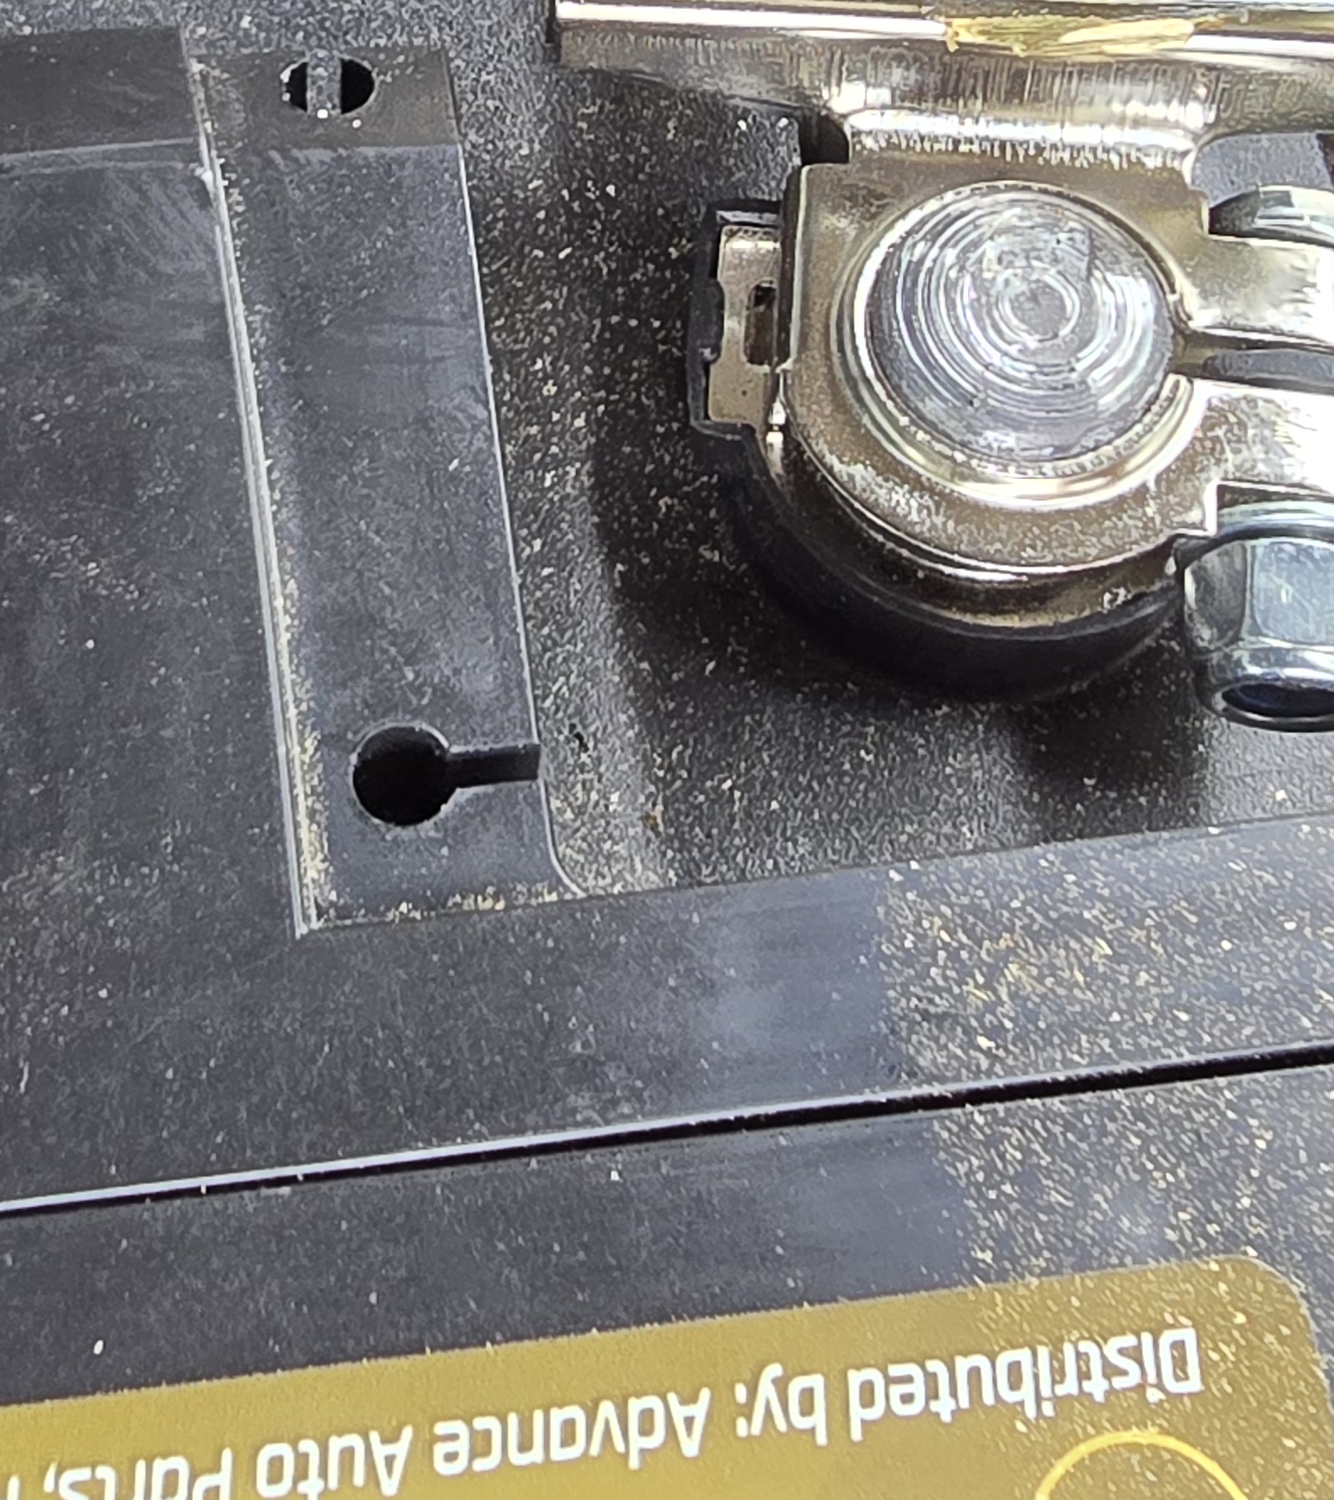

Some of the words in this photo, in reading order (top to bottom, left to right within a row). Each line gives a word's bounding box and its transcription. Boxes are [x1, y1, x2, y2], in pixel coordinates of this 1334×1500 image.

[734, 1362, 828, 1447] by:
[847, 1327, 1204, 1442] Distributed
[255, 1425, 414, 1498] Auto
[432, 1386, 712, 1476] Advance
